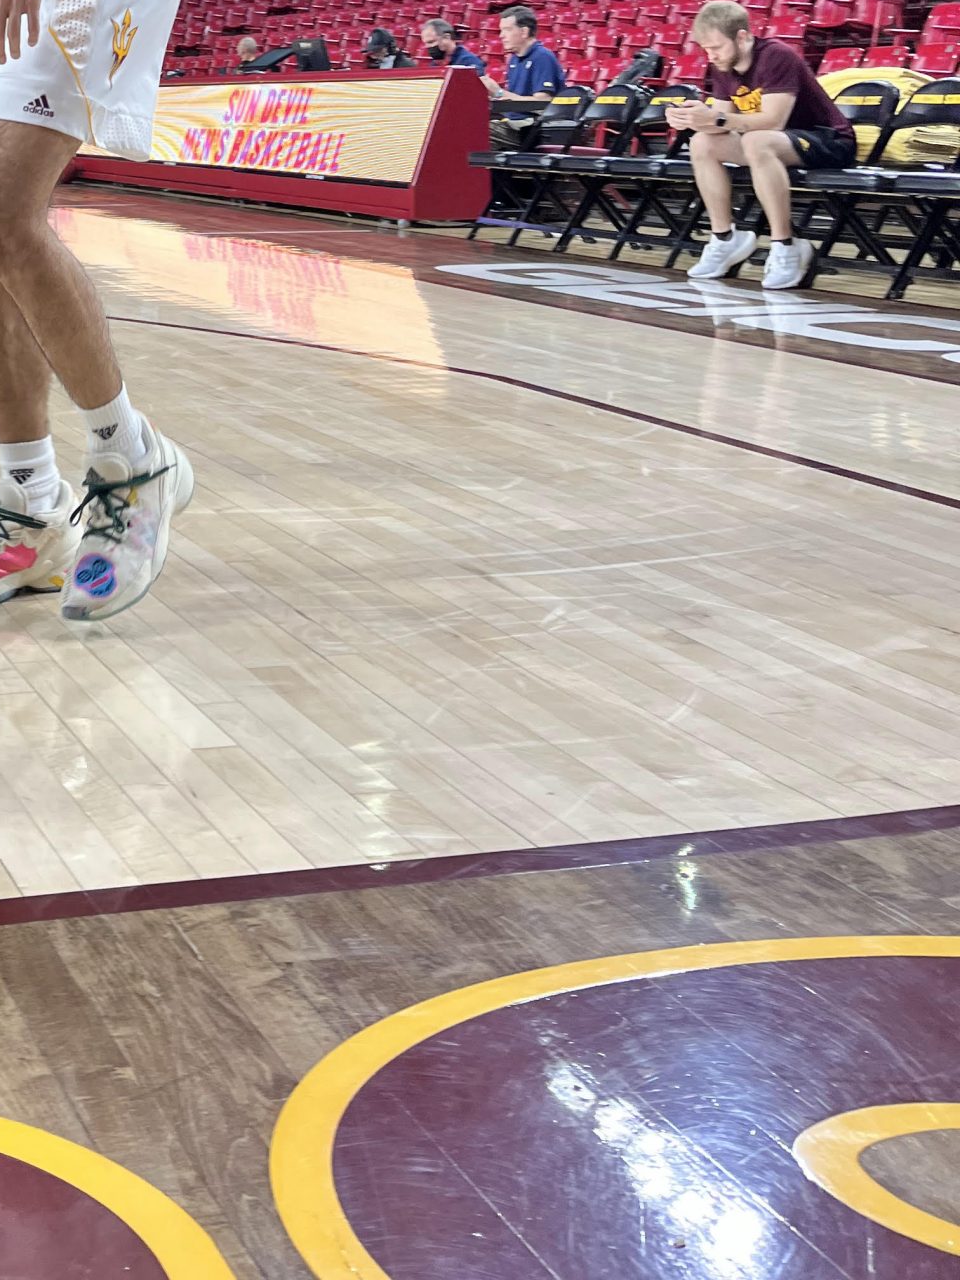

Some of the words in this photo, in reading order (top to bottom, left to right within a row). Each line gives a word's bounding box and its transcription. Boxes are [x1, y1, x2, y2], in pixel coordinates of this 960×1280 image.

[23, 104, 54, 118] adidas
[223, 89, 259, 122] SUN
[259, 88, 314, 124] DEVIL
[180, 128, 230, 163] MEN'S
[227, 129, 346, 173] BASKETBALL
[435, 262, 960, 363] GEIC
